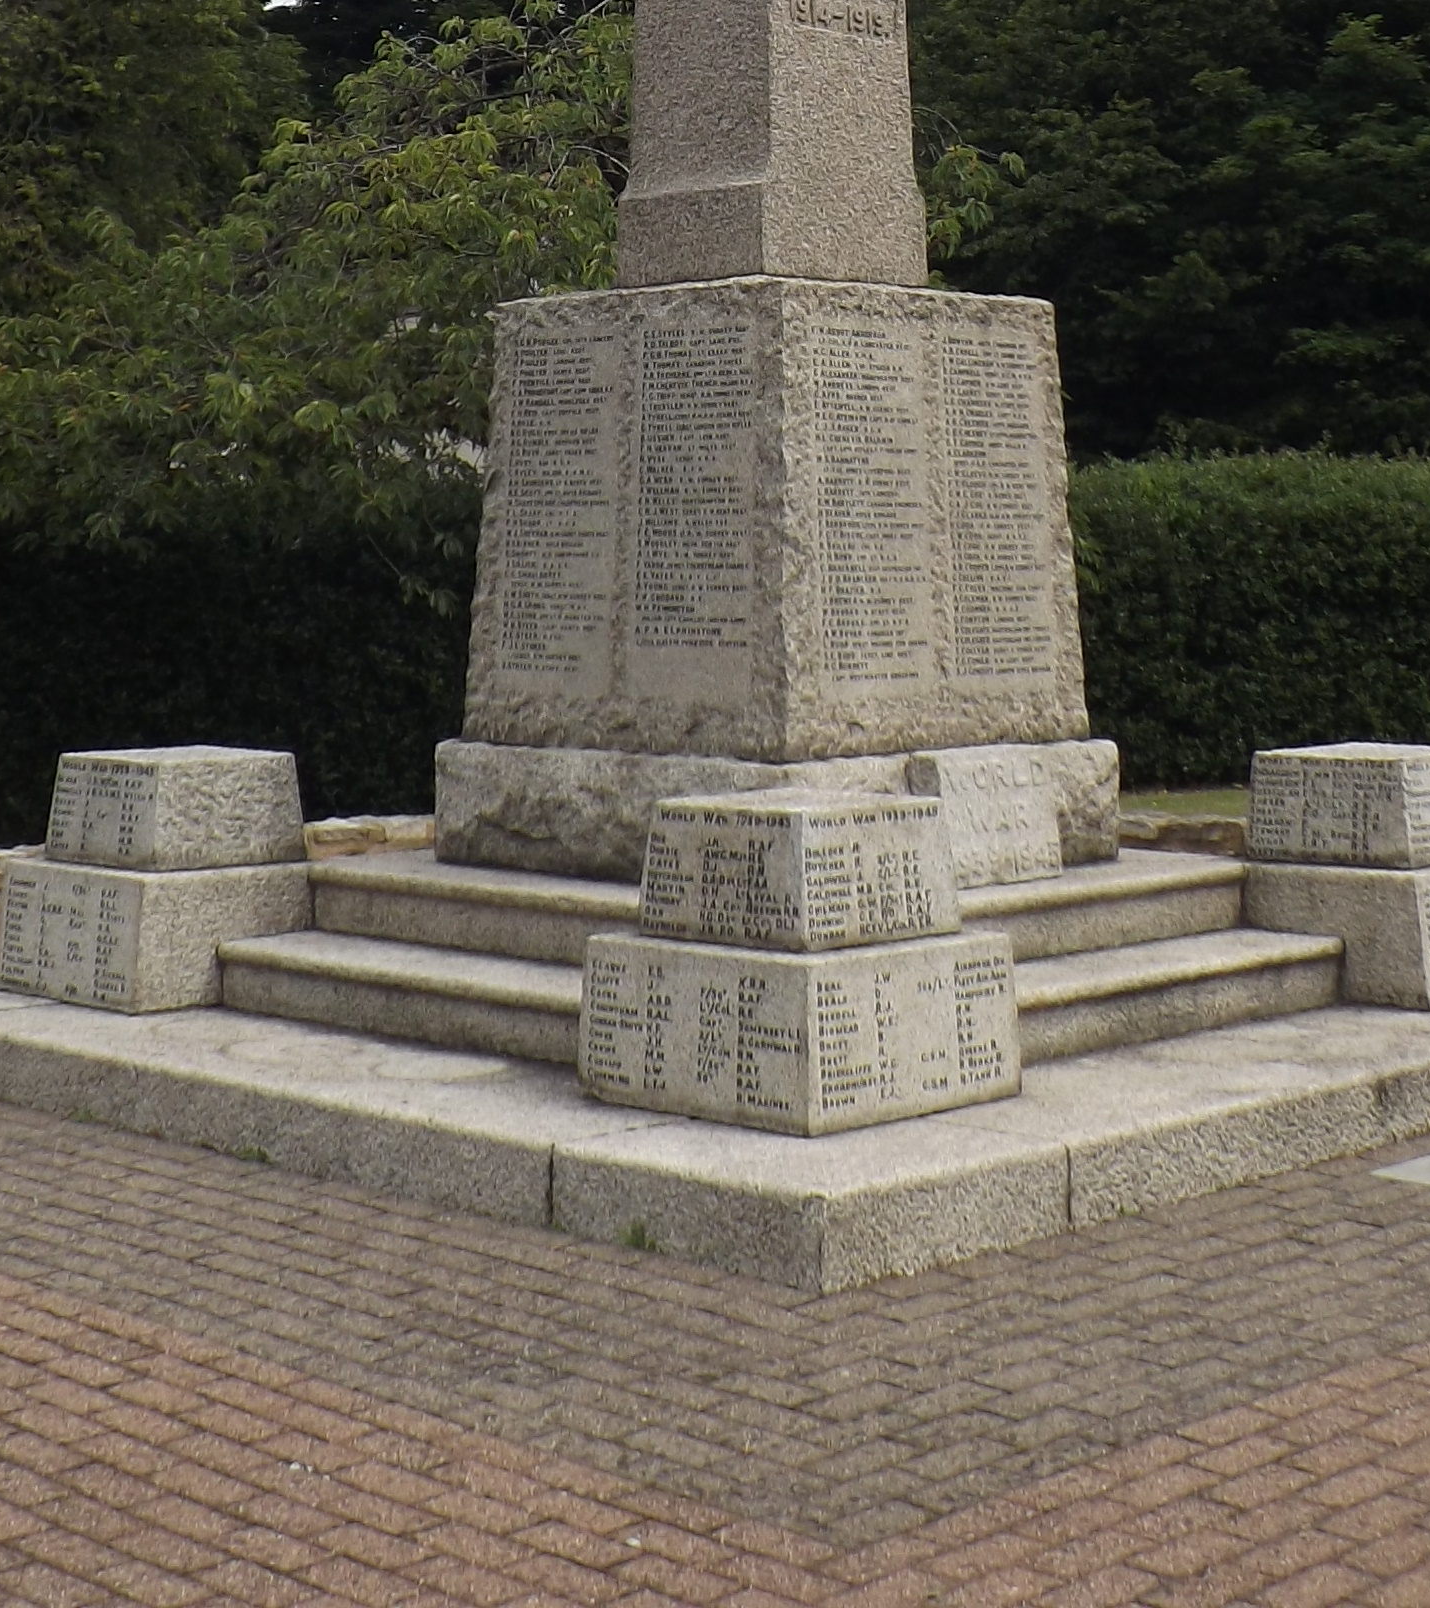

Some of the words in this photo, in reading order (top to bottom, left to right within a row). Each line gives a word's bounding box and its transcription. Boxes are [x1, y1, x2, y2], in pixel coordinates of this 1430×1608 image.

[661, 809, 696, 822] WORLD
[703, 811, 728, 826] WAR
[809, 817, 846, 829] WORLD
[852, 813, 876, 825] WAR
[807, 888, 851, 900] CALDWELL
[817, 981, 842, 993] BEAL
[822, 1095, 855, 1110] BROWN
